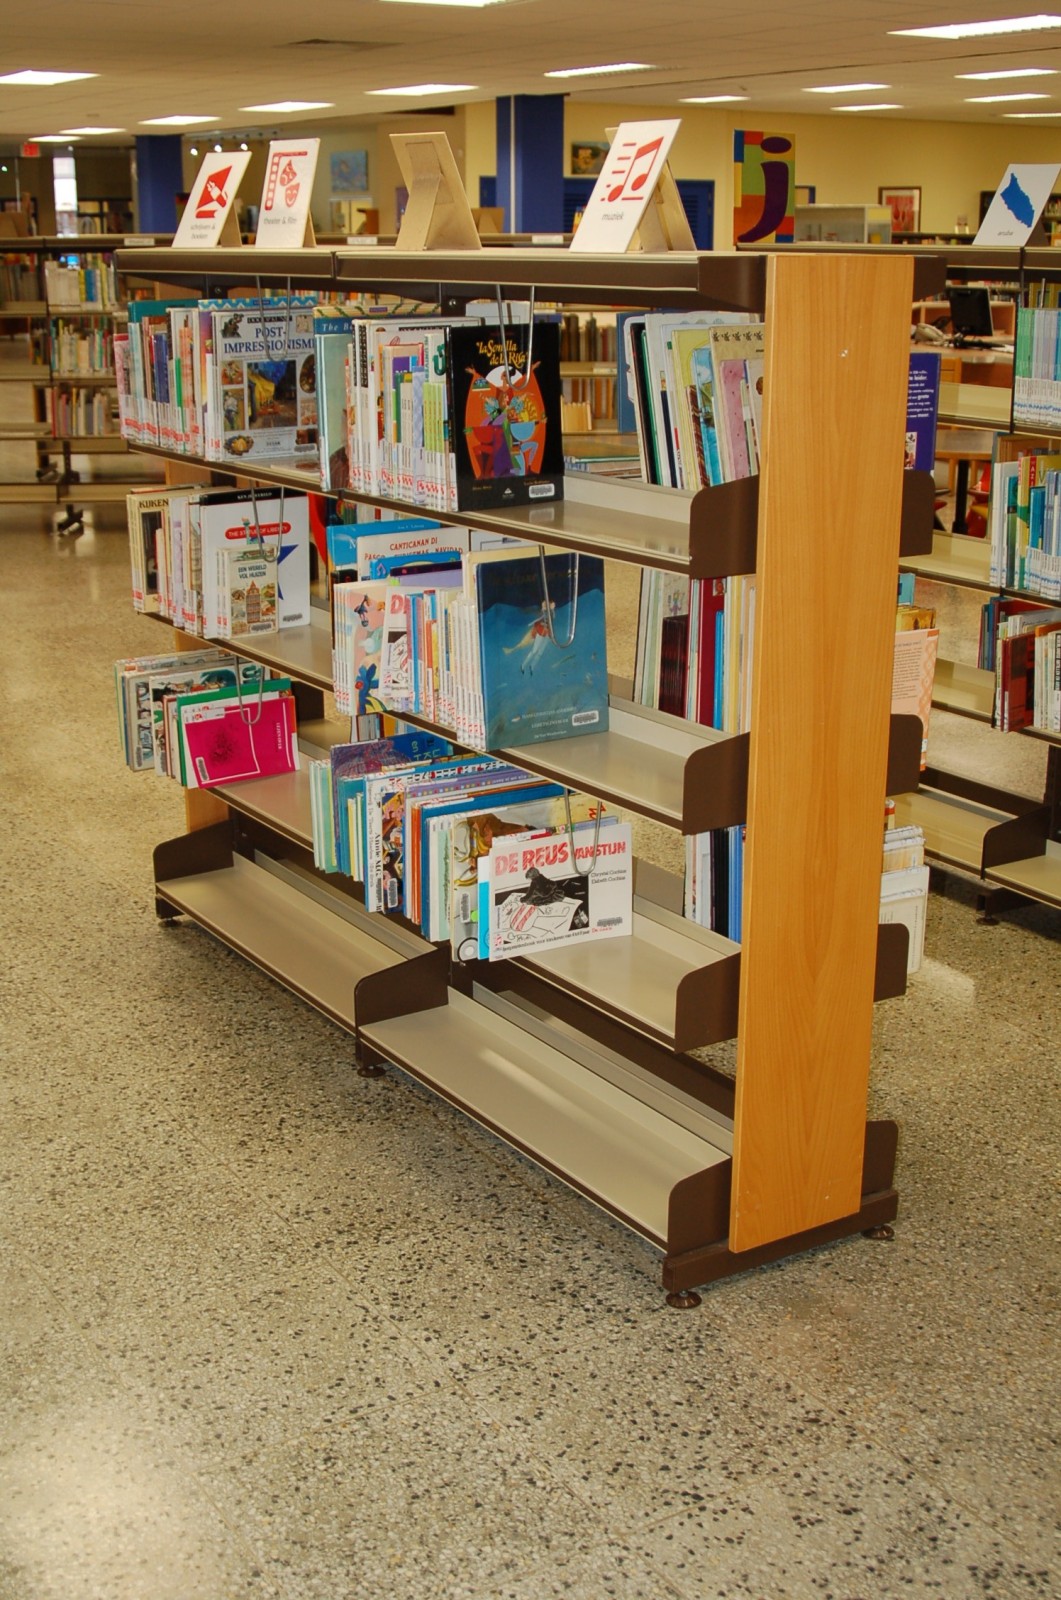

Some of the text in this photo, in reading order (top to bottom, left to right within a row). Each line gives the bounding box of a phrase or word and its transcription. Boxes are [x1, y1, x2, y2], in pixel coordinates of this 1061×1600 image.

[602, 211, 624, 221] muziek
[255, 327, 287, 338] POST-
[322, 323, 338, 332] The
[390, 537, 438, 550] CANTICANAN DI
[374, 833, 382, 857] Annie
[495, 853, 519, 876] DE
[522, 842, 568, 871] REUS
